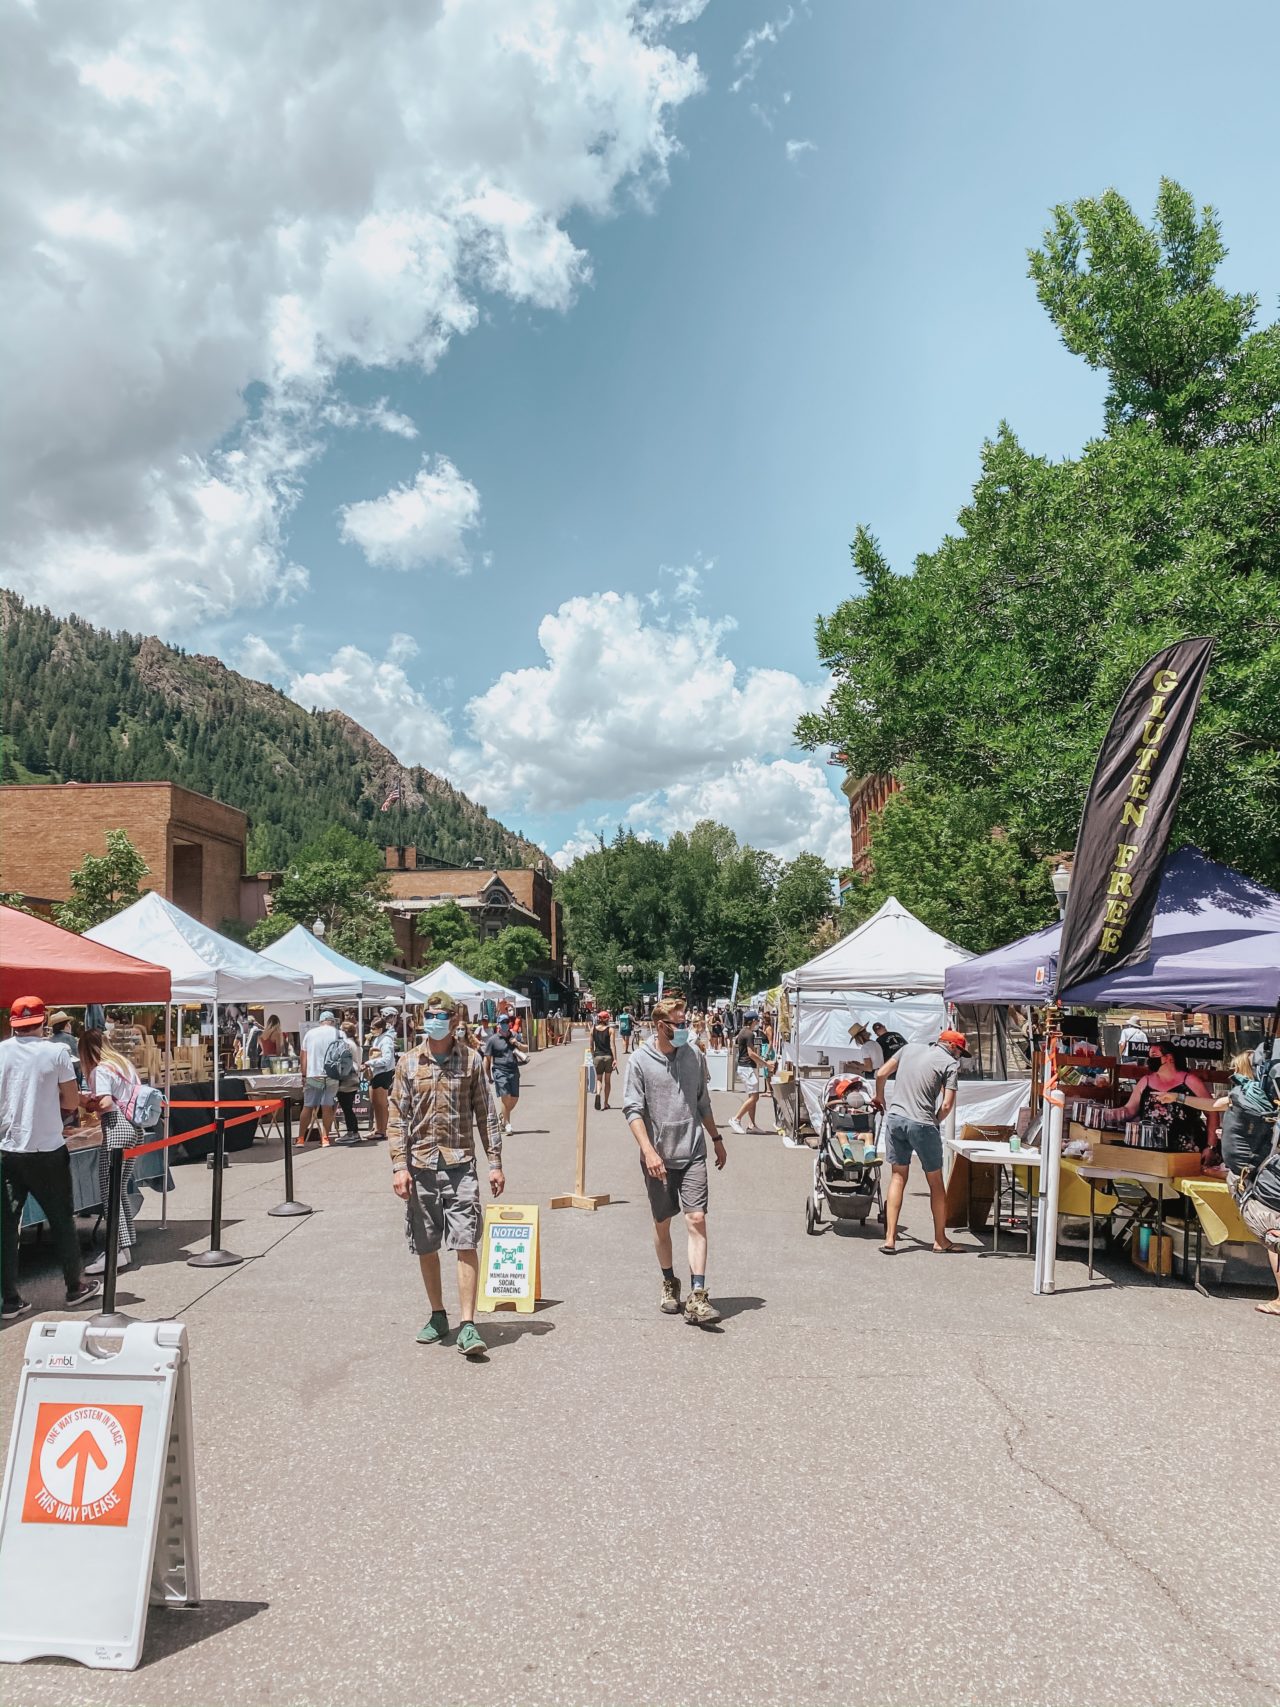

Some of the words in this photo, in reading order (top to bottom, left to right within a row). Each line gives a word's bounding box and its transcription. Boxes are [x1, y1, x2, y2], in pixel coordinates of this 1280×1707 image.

[1119, 668, 1179, 829] GLUTEN
[1097, 842, 1139, 955] FREE
[1170, 1035, 1223, 1050] Cookies
[493, 1228, 528, 1237] NOTICE
[46, 1427, 61, 1445] ONE
[57, 1415, 73, 1430] WAY
[74, 1408, 103, 1421] SYSTEM
[101, 1414, 111, 1426] IN
[107, 1420, 124, 1446] PLACE
[34, 1486, 57, 1514] THIS
[55, 1503, 80, 1522] WAY
[81, 1489, 121, 1522] PLEASE
